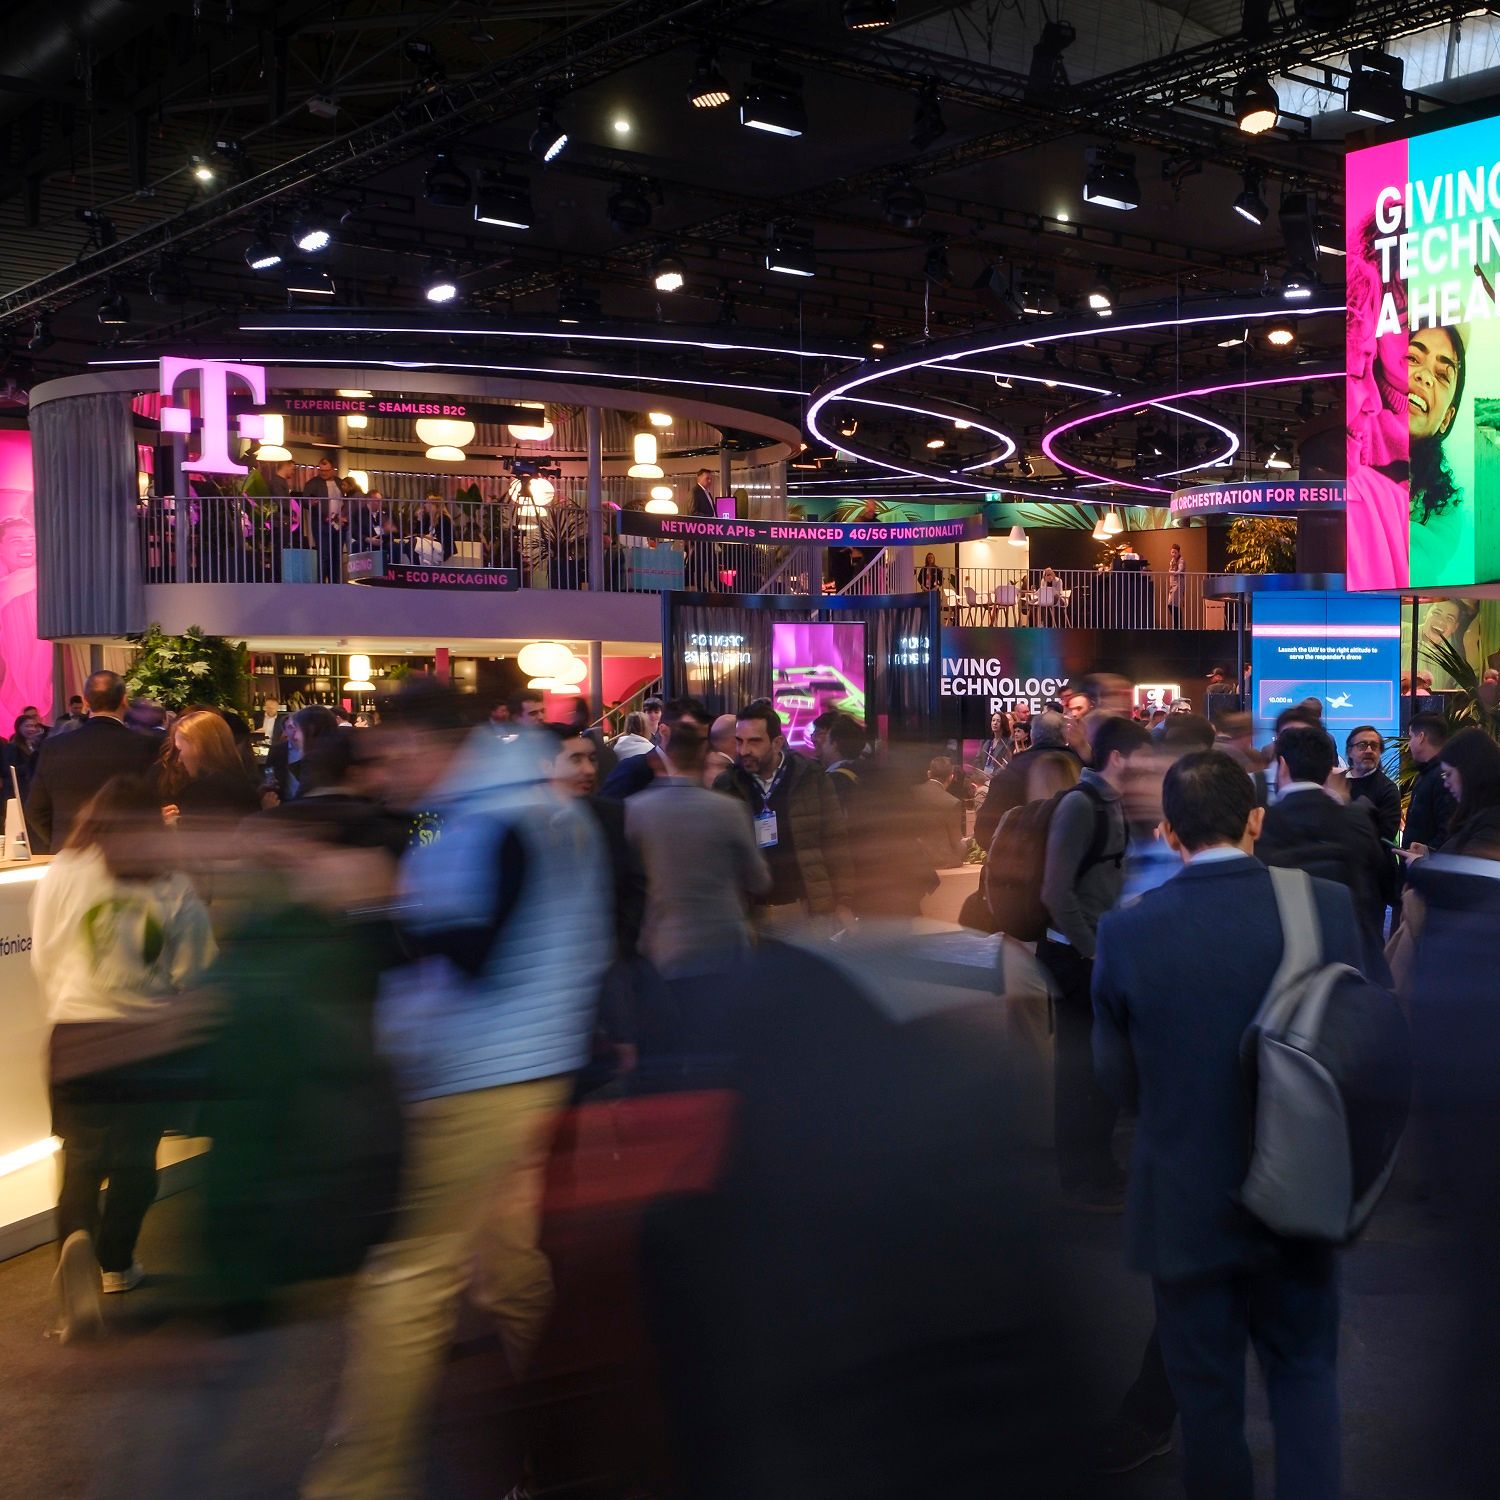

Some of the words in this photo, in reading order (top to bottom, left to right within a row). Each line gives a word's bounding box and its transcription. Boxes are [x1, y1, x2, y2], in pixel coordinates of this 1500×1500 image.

[1375, 292, 1402, 338] A
[284, 400, 292, 410] T
[294, 400, 365, 411] EXPERIENCE
[378, 402, 440, 415] SEAMLESS
[442, 404, 466, 417] B2C
[1178, 490, 1262, 510] ORCHESTRATION
[1266, 488, 1295, 502] FOR
[661, 520, 724, 536] NETWORK
[727, 525, 756, 537] APIs
[770, 527, 844, 540] ENHANCED
[849, 526, 888, 541] 4G/5G
[890, 524, 964, 539] FUNCTIONALITY
[406, 571, 429, 583] ECO
[432, 573, 508, 585] PACKAGING
